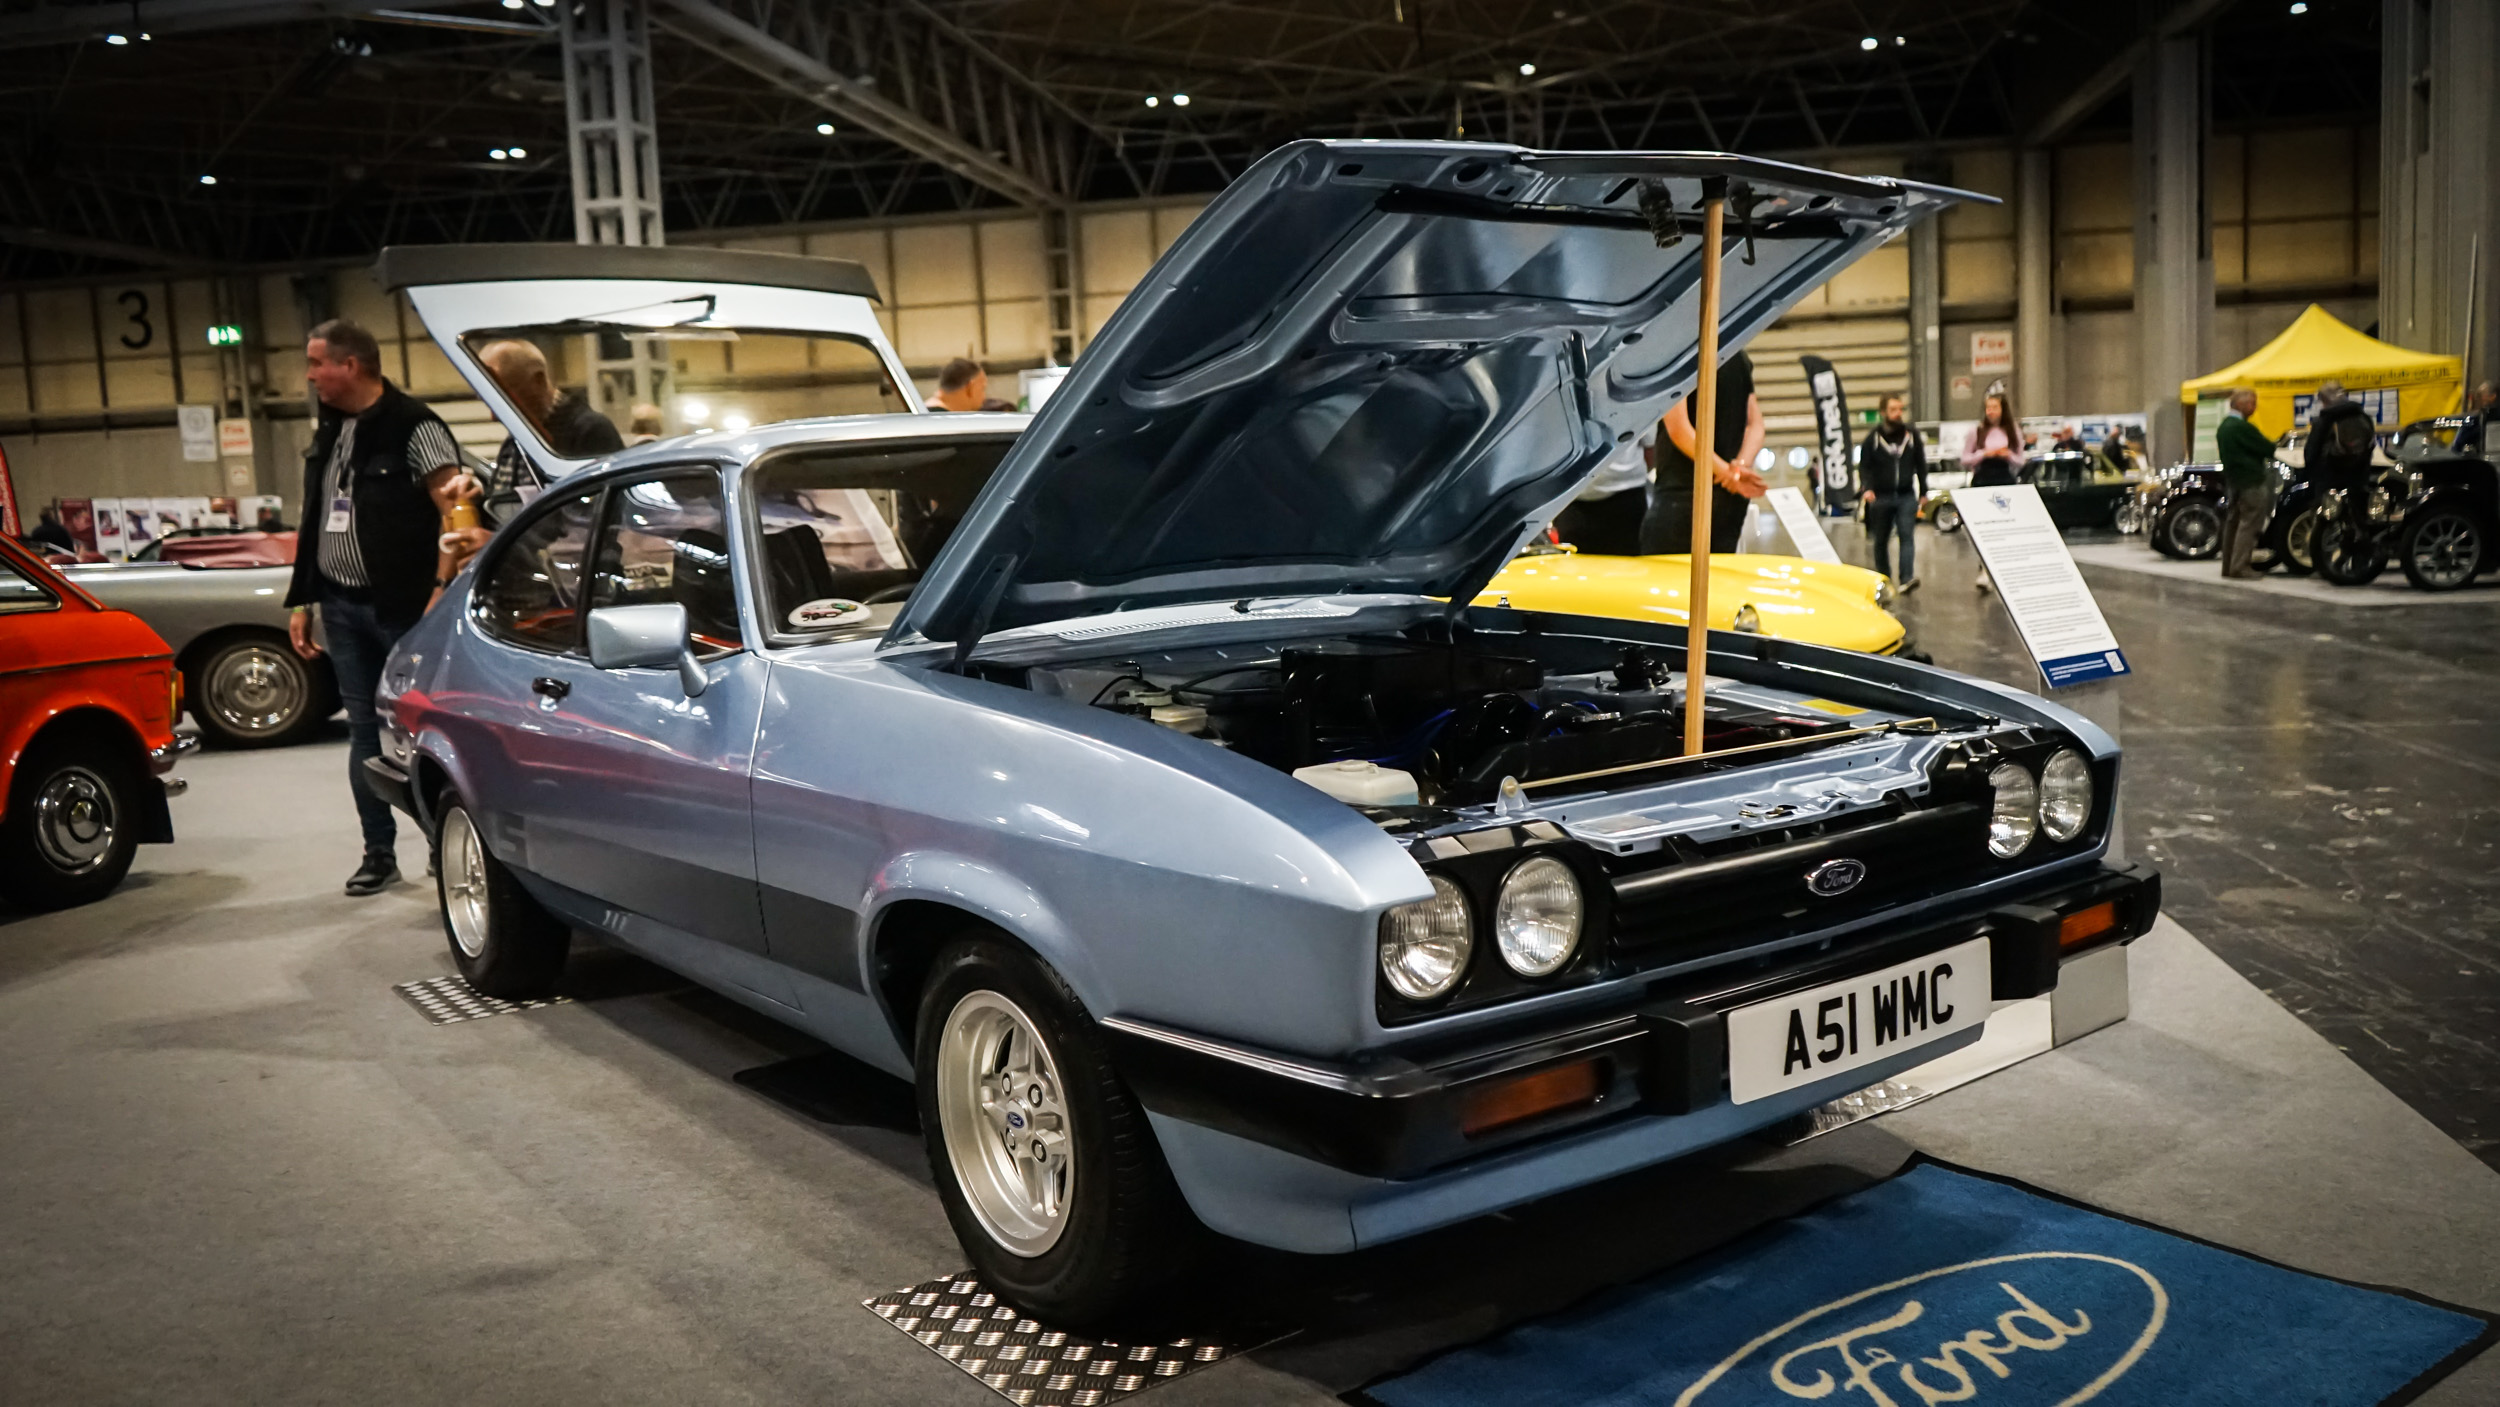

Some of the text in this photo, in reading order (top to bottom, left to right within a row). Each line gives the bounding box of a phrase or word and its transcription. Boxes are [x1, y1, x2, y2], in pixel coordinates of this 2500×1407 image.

[117, 288, 153, 351] 3
[1823, 867, 1854, 889] Ford
[1783, 963, 1954, 1076] A51 WMC
[1770, 1282, 2092, 1407] Ford
